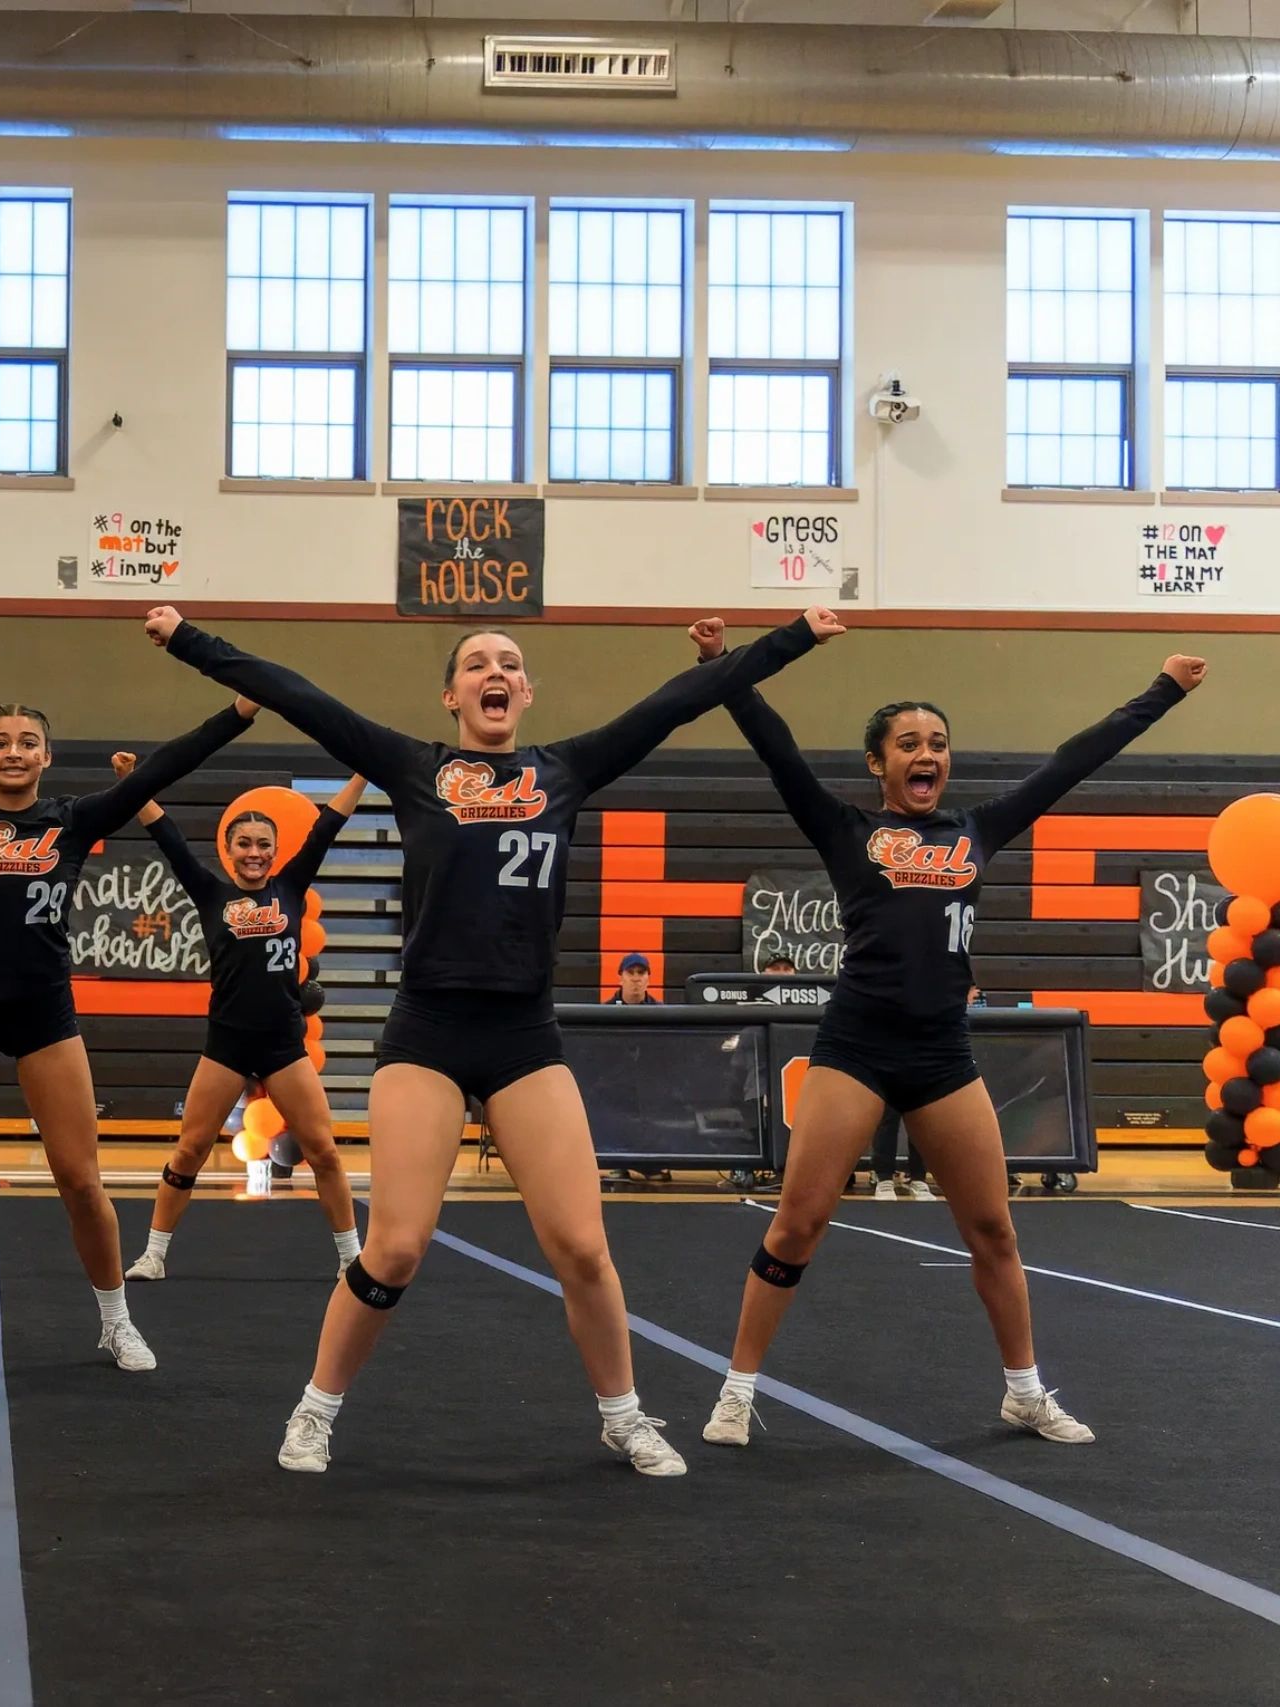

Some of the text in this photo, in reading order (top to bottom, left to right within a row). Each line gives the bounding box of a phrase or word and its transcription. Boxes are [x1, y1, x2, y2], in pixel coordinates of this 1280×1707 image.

[93, 512, 182, 537] #9 on the
[766, 516, 838, 543] Gregs
[99, 534, 177, 555] mat but
[453, 537, 484, 560] the
[1144, 544, 1216, 560] THE MAT
[91, 556, 163, 584] #1 in my
[779, 555, 805, 581] 10
[1175, 565, 1195, 581] IN
[1200, 566, 1224, 581] MY
[1153, 581, 1205, 593] HEART
[460, 806, 527, 819] GRIZZLIES
[498, 829, 557, 889] 27
[871, 830, 977, 873] Cal
[894, 871, 957, 887] GRIZZLIES
[25, 881, 67, 925] 29
[265, 937, 296, 972] 23
[720, 988, 818, 1004] BONUS POSS
